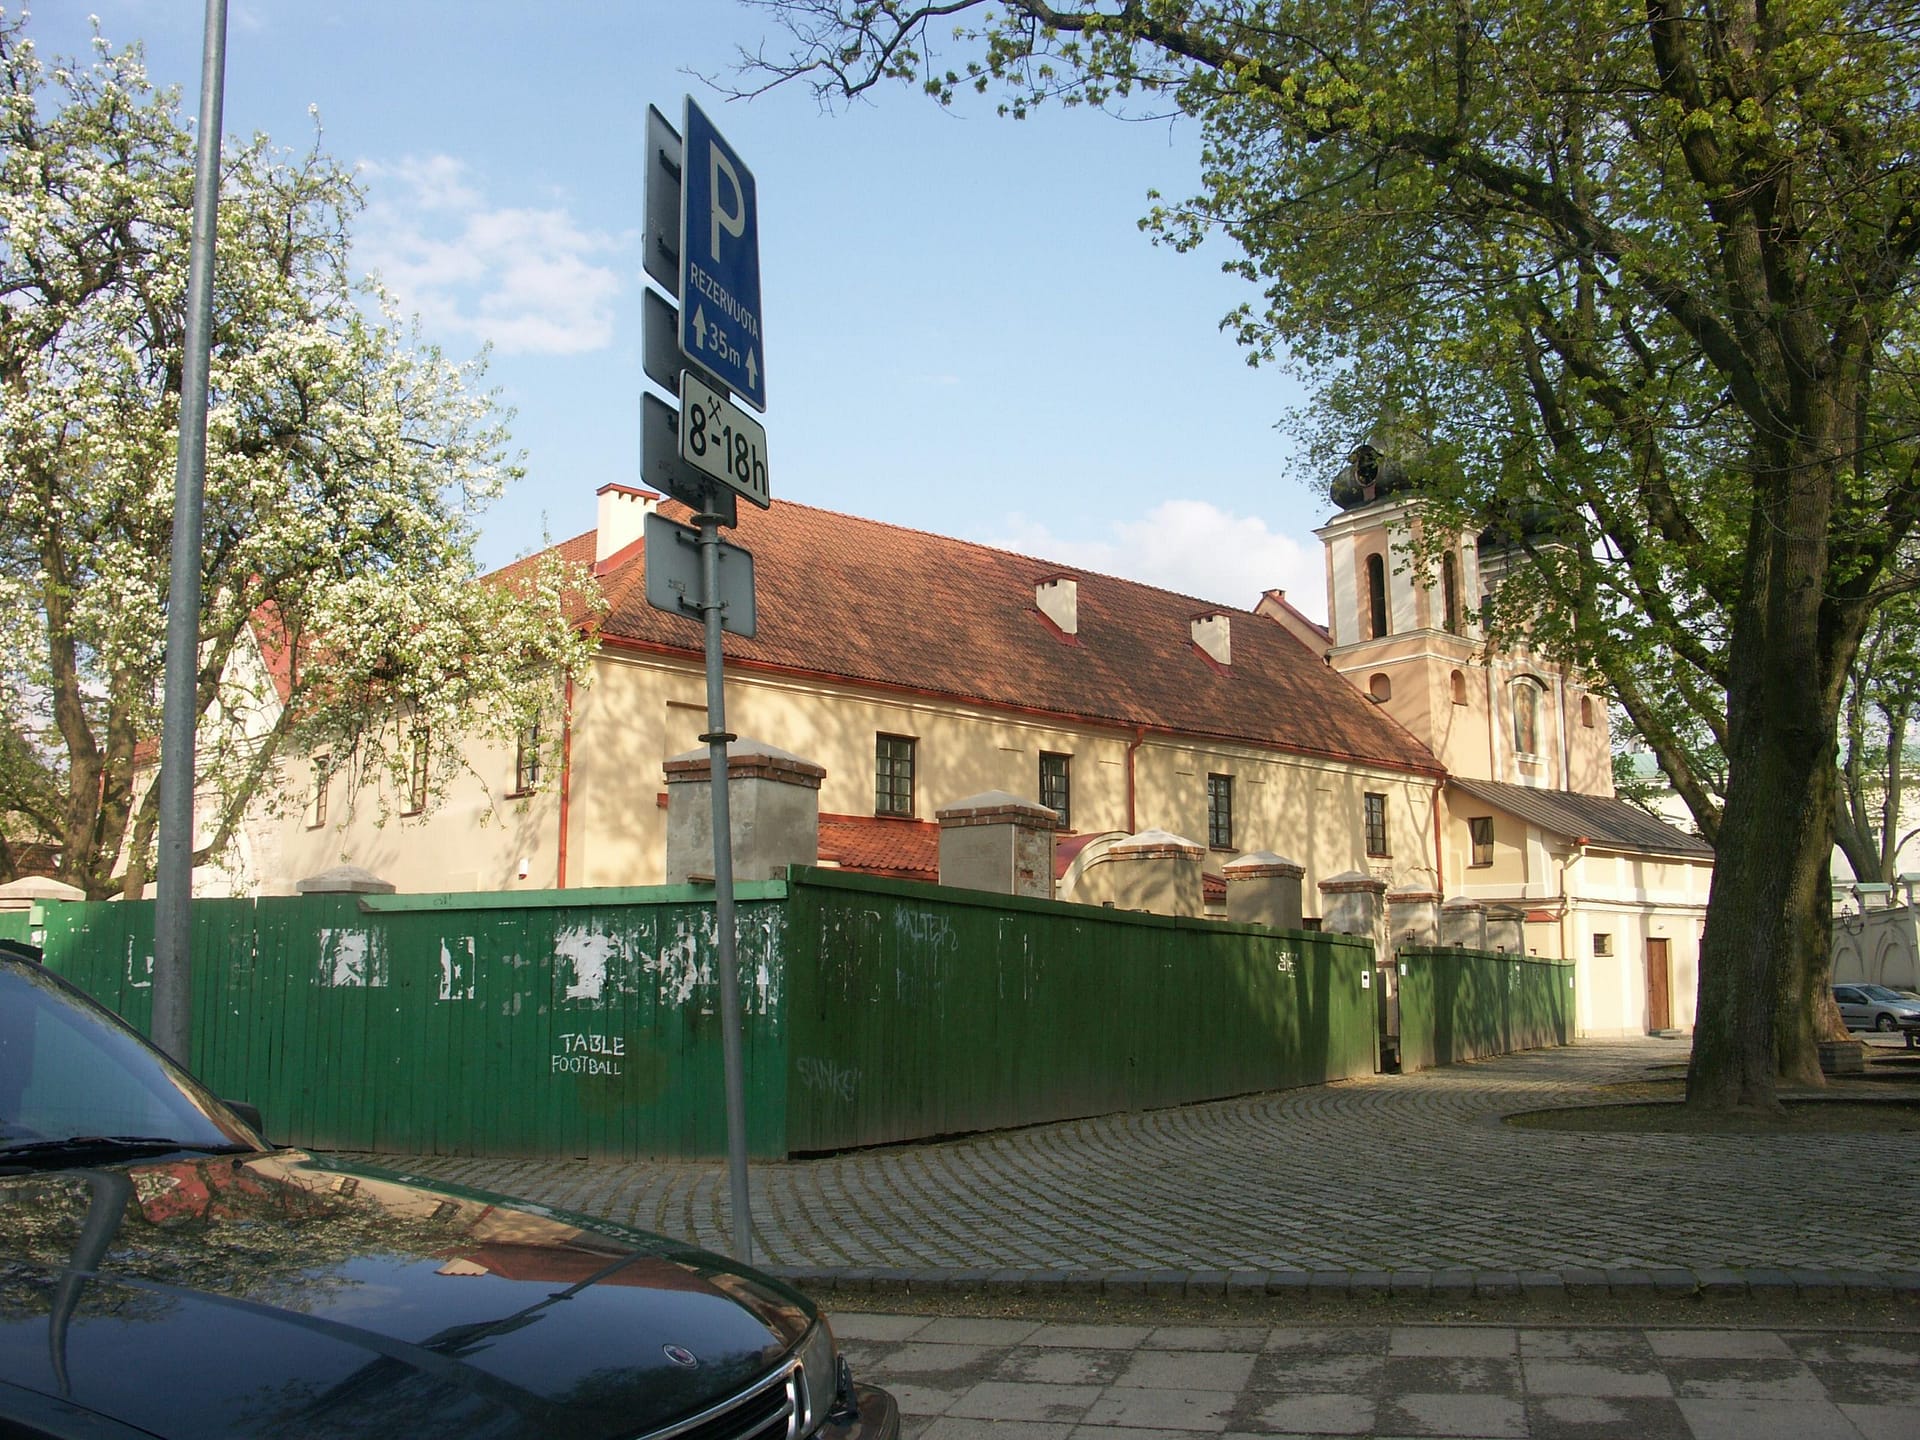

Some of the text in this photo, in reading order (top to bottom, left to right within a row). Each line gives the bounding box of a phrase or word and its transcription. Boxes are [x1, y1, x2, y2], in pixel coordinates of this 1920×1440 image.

[710, 139, 745, 264] P
[690, 261, 759, 340] REZERVUOTA
[690, 403, 766, 496] 8-18h
[552, 1054, 621, 1075] FOOTBALL
[559, 1033, 625, 1056] TABLE
